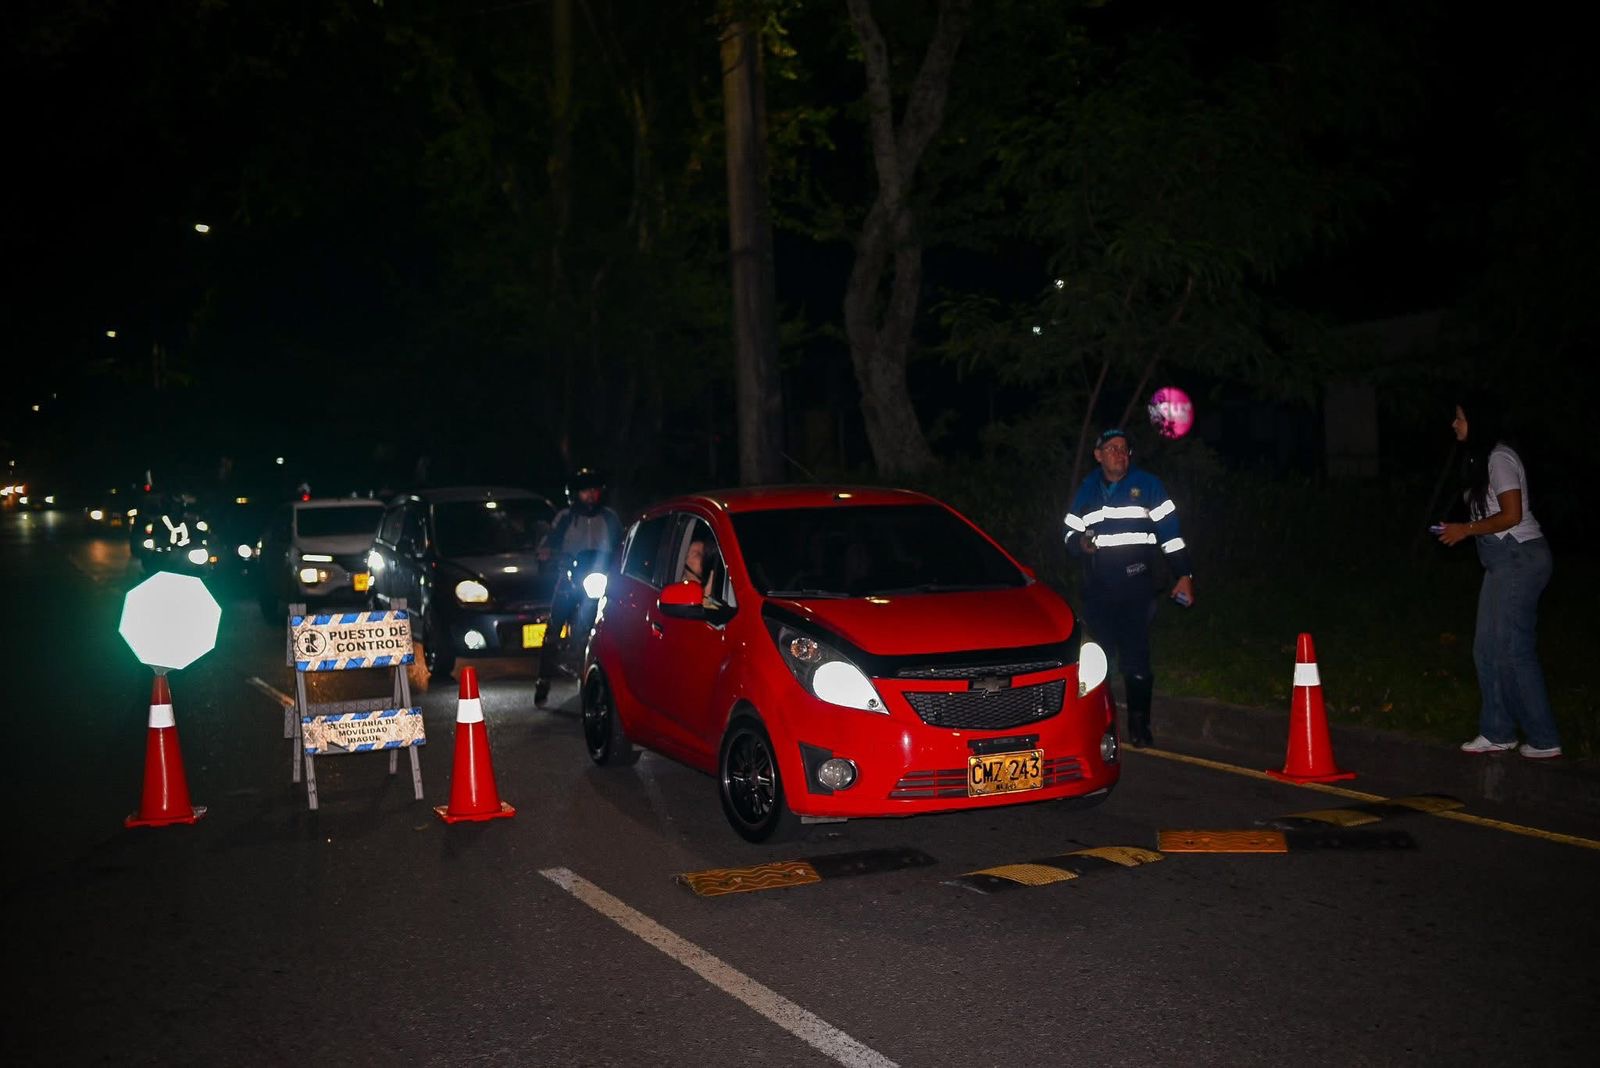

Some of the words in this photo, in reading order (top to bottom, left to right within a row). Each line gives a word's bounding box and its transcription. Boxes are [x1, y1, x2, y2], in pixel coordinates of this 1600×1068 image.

[329, 628, 384, 641] PUESTO
[389, 625, 408, 637] DE
[336, 639, 404, 653] CONTROL
[338, 727, 388, 737] MOVILIDAD
[972, 762, 1003, 784] CMZ
[1009, 756, 1040, 781] 243
